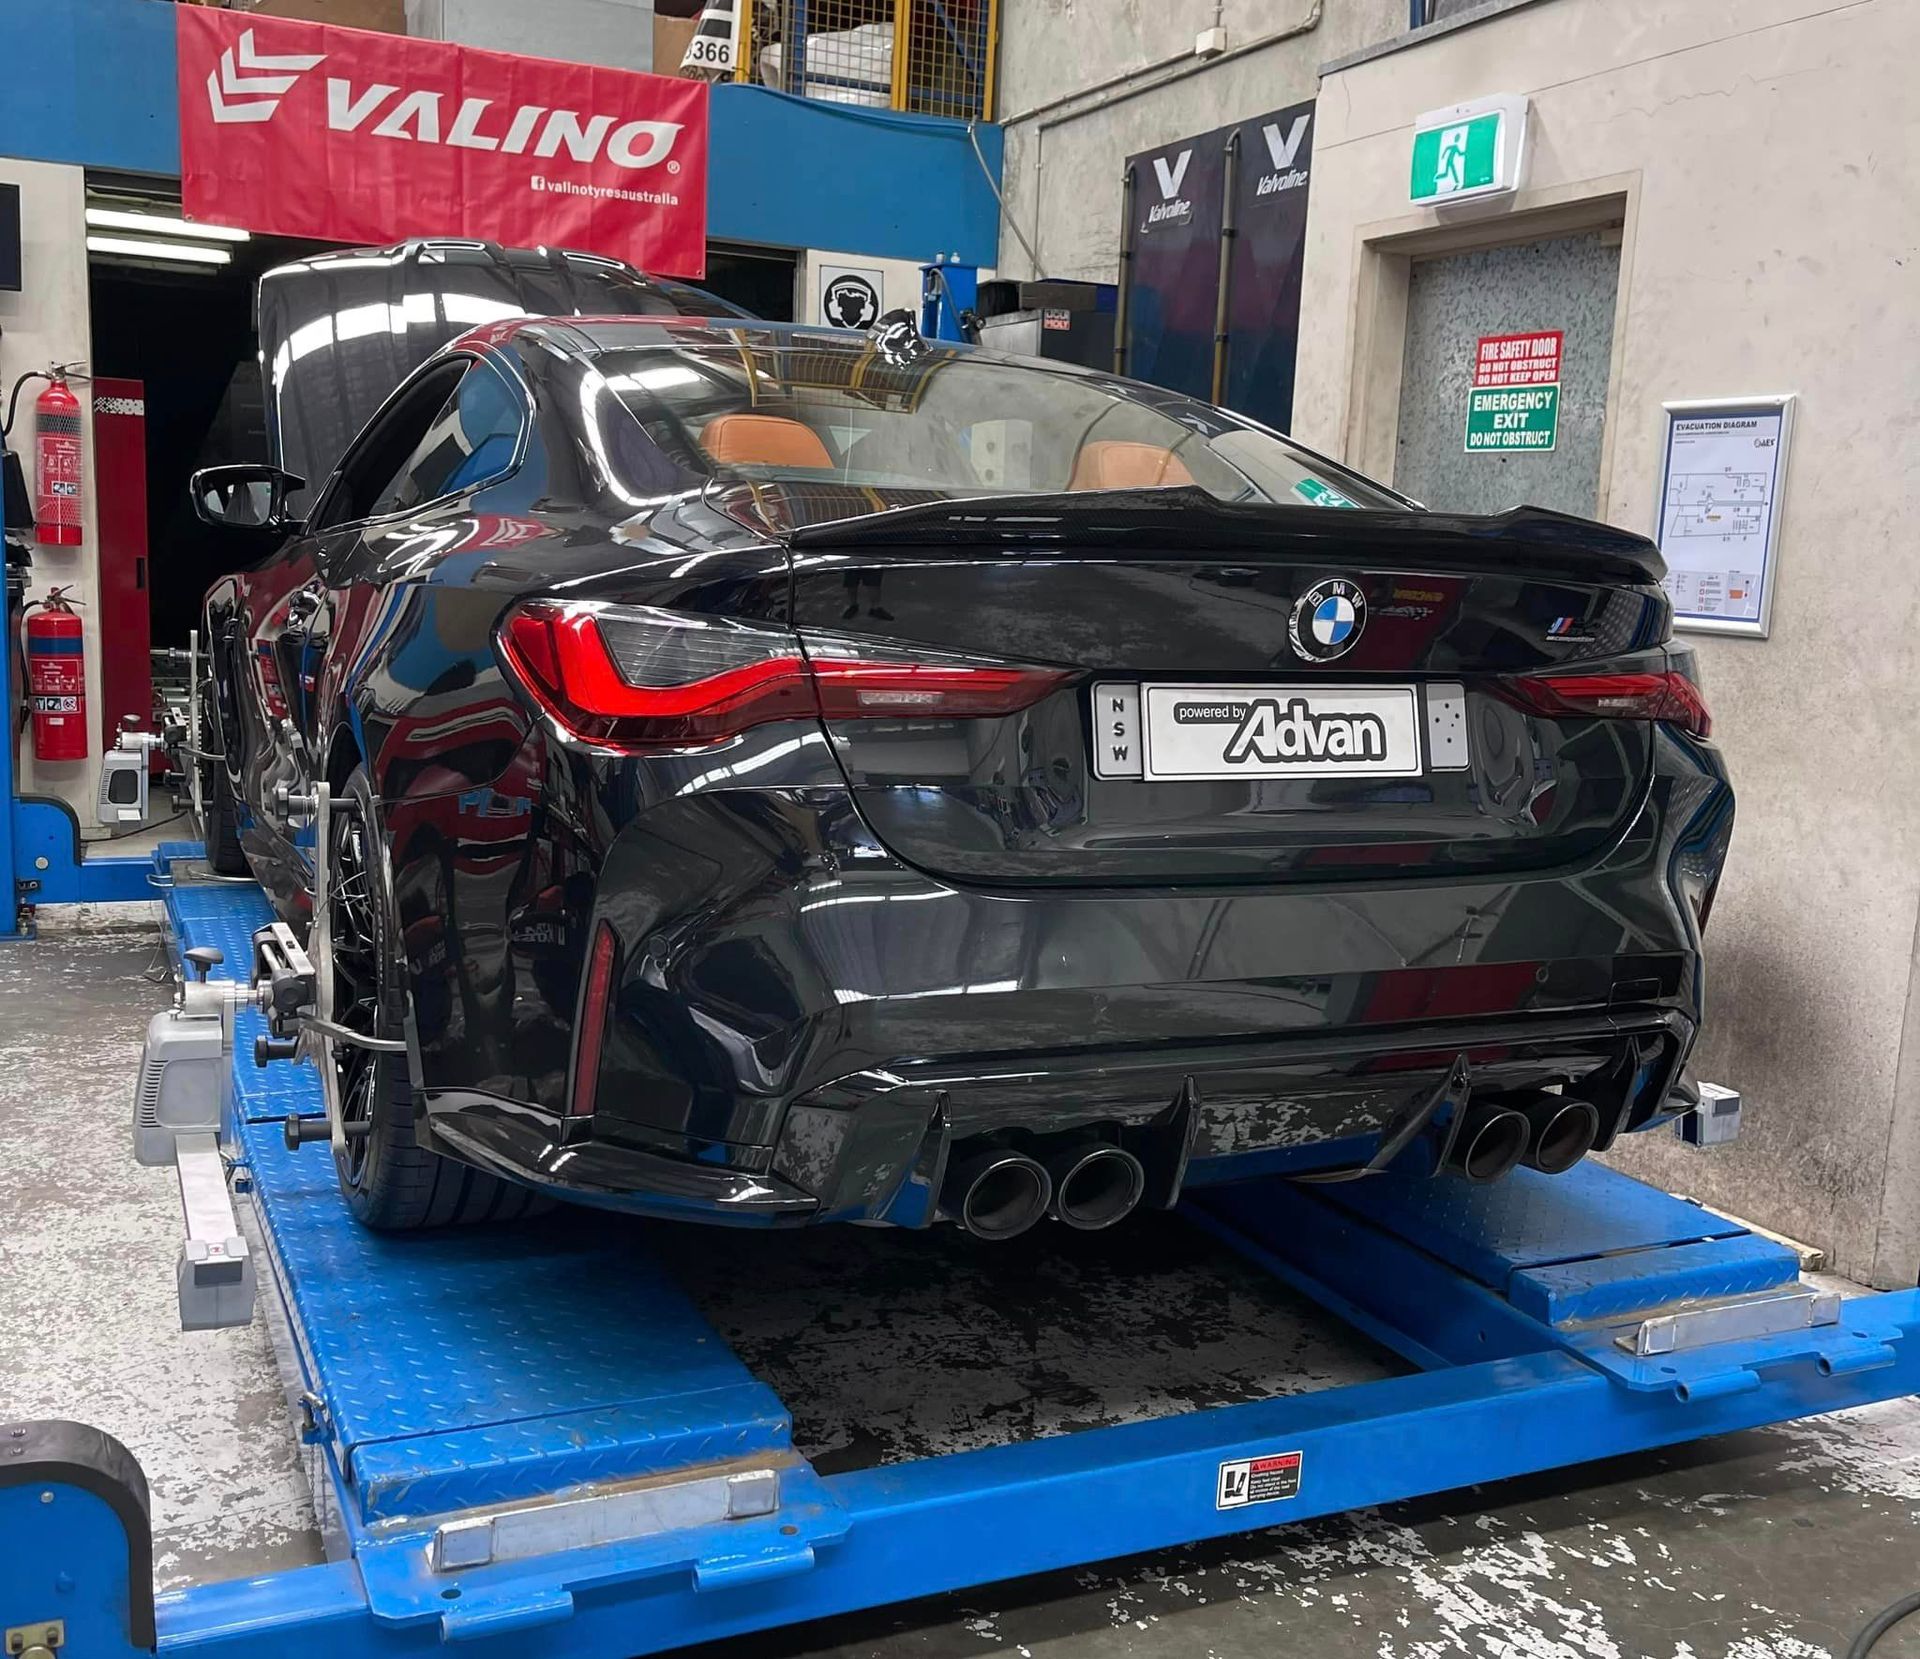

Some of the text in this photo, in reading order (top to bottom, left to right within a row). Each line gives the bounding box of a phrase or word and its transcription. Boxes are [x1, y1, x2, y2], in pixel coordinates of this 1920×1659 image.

[327, 77, 685, 168] VALINO
[1256, 169, 1308, 196] Valvoline
[547, 181, 679, 206] valinotyresaustralia
[1148, 199, 1191, 223] Valvoline
[1481, 337, 1557, 361] FIRE SAFETY DOOR
[1480, 358, 1557, 373] DO NOT OBSTRUCT
[1478, 370, 1556, 385] DO NOT KEEP OPEN
[1474, 392, 1553, 411] EMERGENCY
[1493, 413, 1529, 429] EXIT
[1676, 421, 1757, 430] EVACUATION DIAGRAM
[1470, 431, 1551, 446] DO NOT OBSTRUCT
[1308, 582, 1364, 609] BMW
[1179, 705, 1246, 721] powered by
[1228, 703, 1383, 759] Advan
